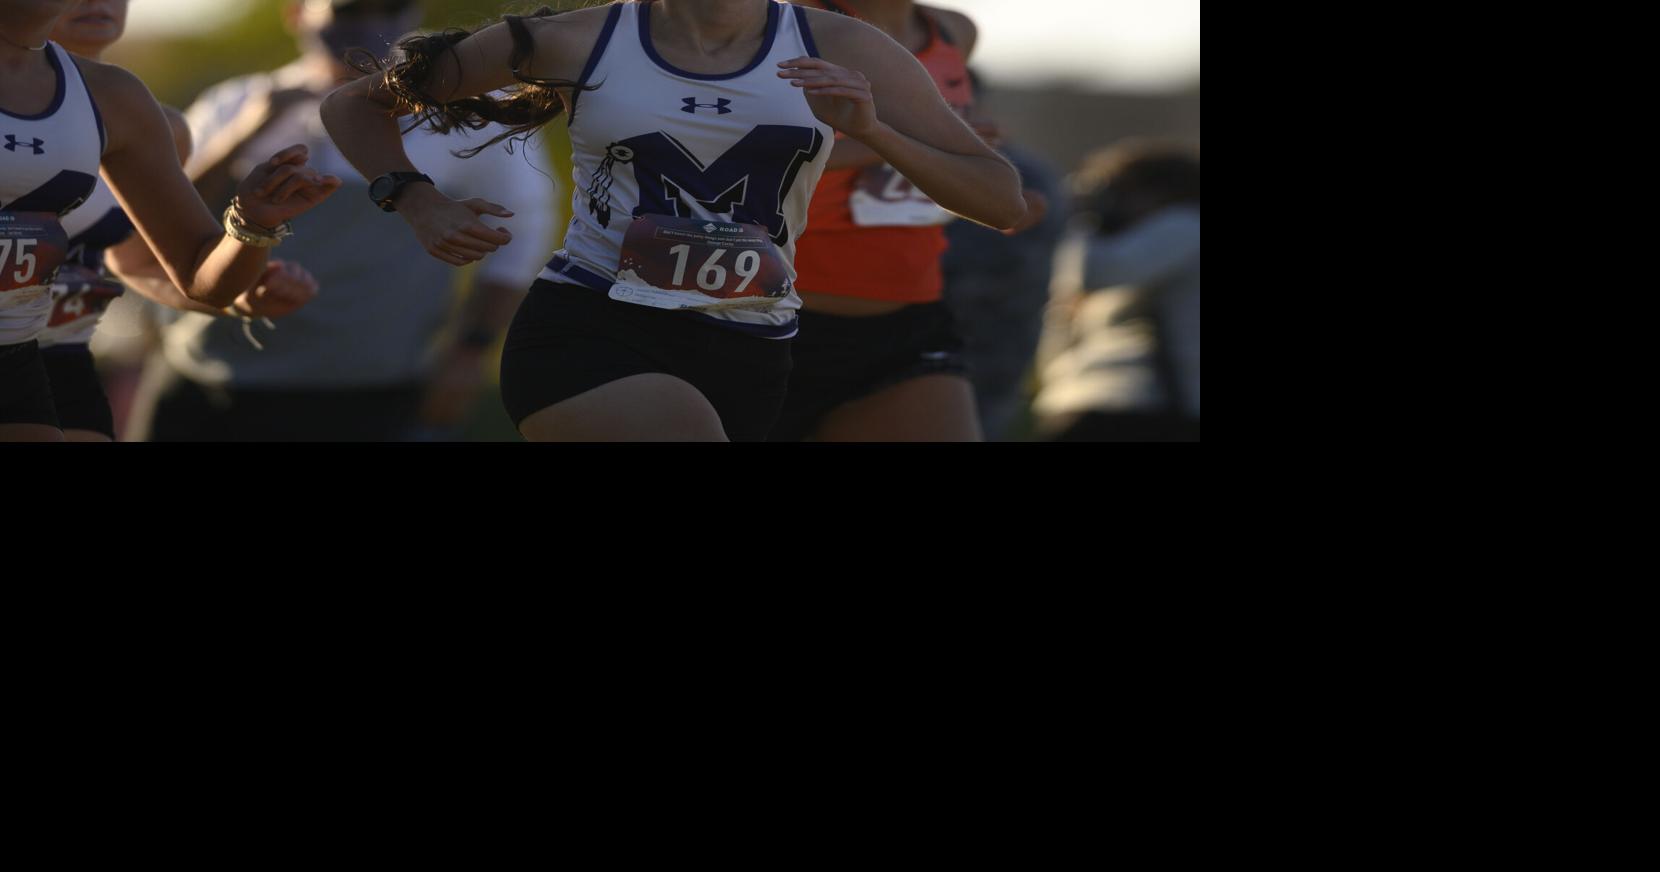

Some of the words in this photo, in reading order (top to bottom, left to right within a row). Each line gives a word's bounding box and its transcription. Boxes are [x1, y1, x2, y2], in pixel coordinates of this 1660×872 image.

[618, 124, 824, 247] M
[0, 238, 38, 283] 75
[669, 243, 761, 293] 169
